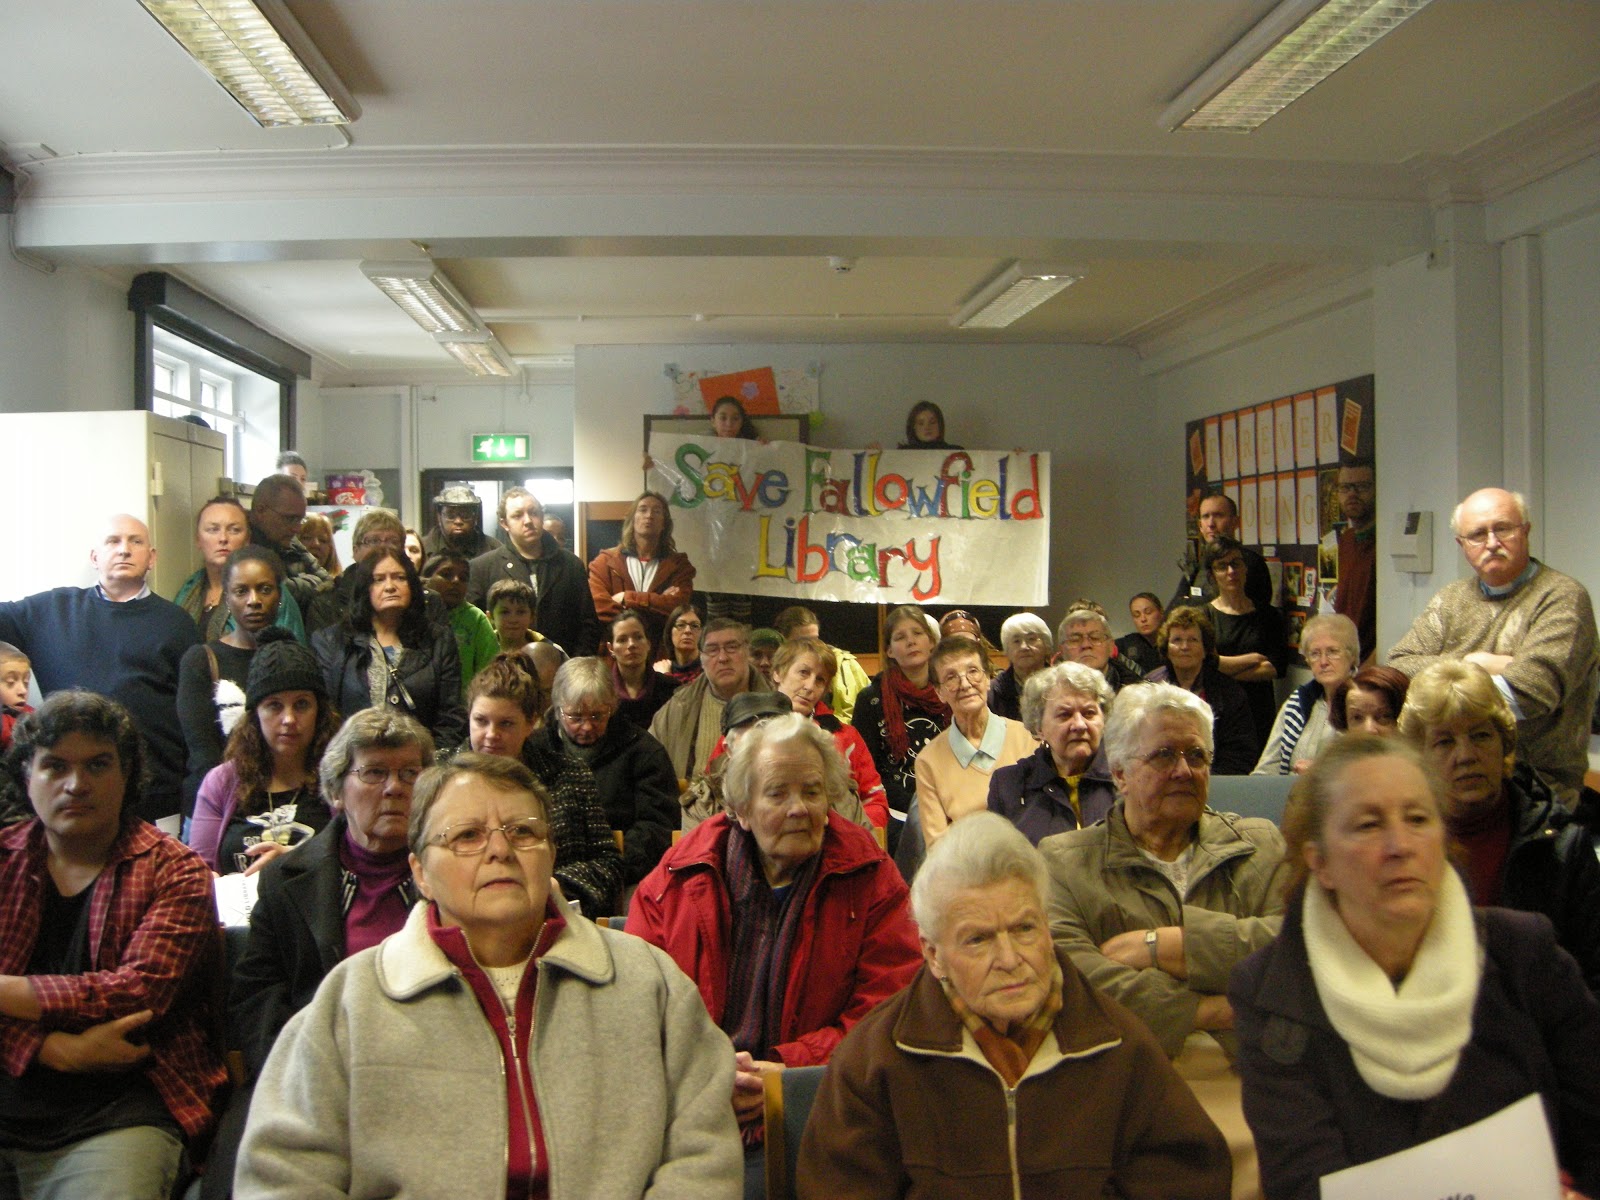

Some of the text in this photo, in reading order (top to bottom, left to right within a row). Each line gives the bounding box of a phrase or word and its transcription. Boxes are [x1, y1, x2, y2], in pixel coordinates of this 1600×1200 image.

[1207, 412, 1335, 465] FOREVER
[671, 443, 1044, 521] Save Fallowfield
[1244, 494, 1316, 527] OUNG
[750, 514, 942, 600] Library
